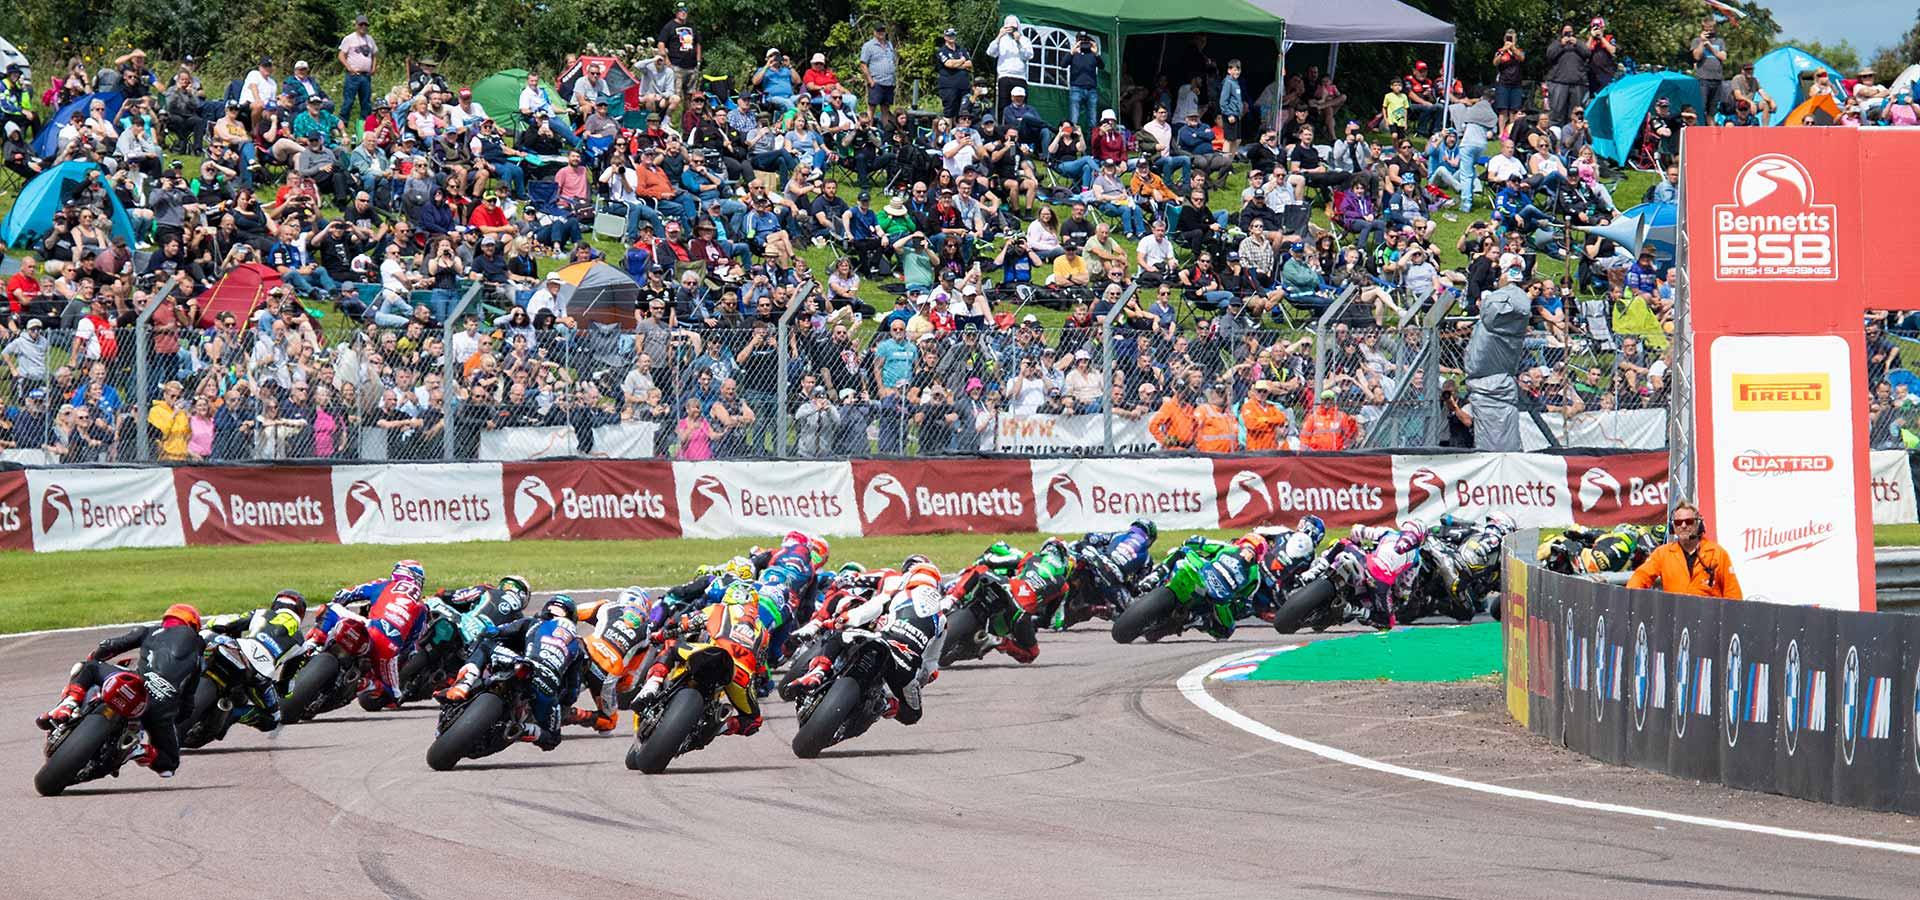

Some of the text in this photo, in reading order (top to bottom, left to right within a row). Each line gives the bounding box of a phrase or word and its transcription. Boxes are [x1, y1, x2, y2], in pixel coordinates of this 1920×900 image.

[1719, 211, 1830, 232] Bennetts
[1720, 234, 1831, 266] BSB
[1721, 267, 1832, 275] BRITISH SUPERBIKES
[1740, 383, 1822, 401] PIRELLI
[1738, 456, 1827, 470] QUATTRO
[390, 492, 490, 522] Bennetts
[562, 487, 666, 519] Bennetts
[741, 488, 842, 518] Bennetts
[915, 486, 1023, 516] Bennetts
[1092, 486, 1201, 514] Bennetts
[1277, 481, 1384, 512] Bennetts
[1456, 479, 1557, 508] Bennetts
[81, 498, 167, 529] Bennetts
[230, 494, 324, 526] Bennetts
[1741, 520, 1833, 553] Milwaukee
